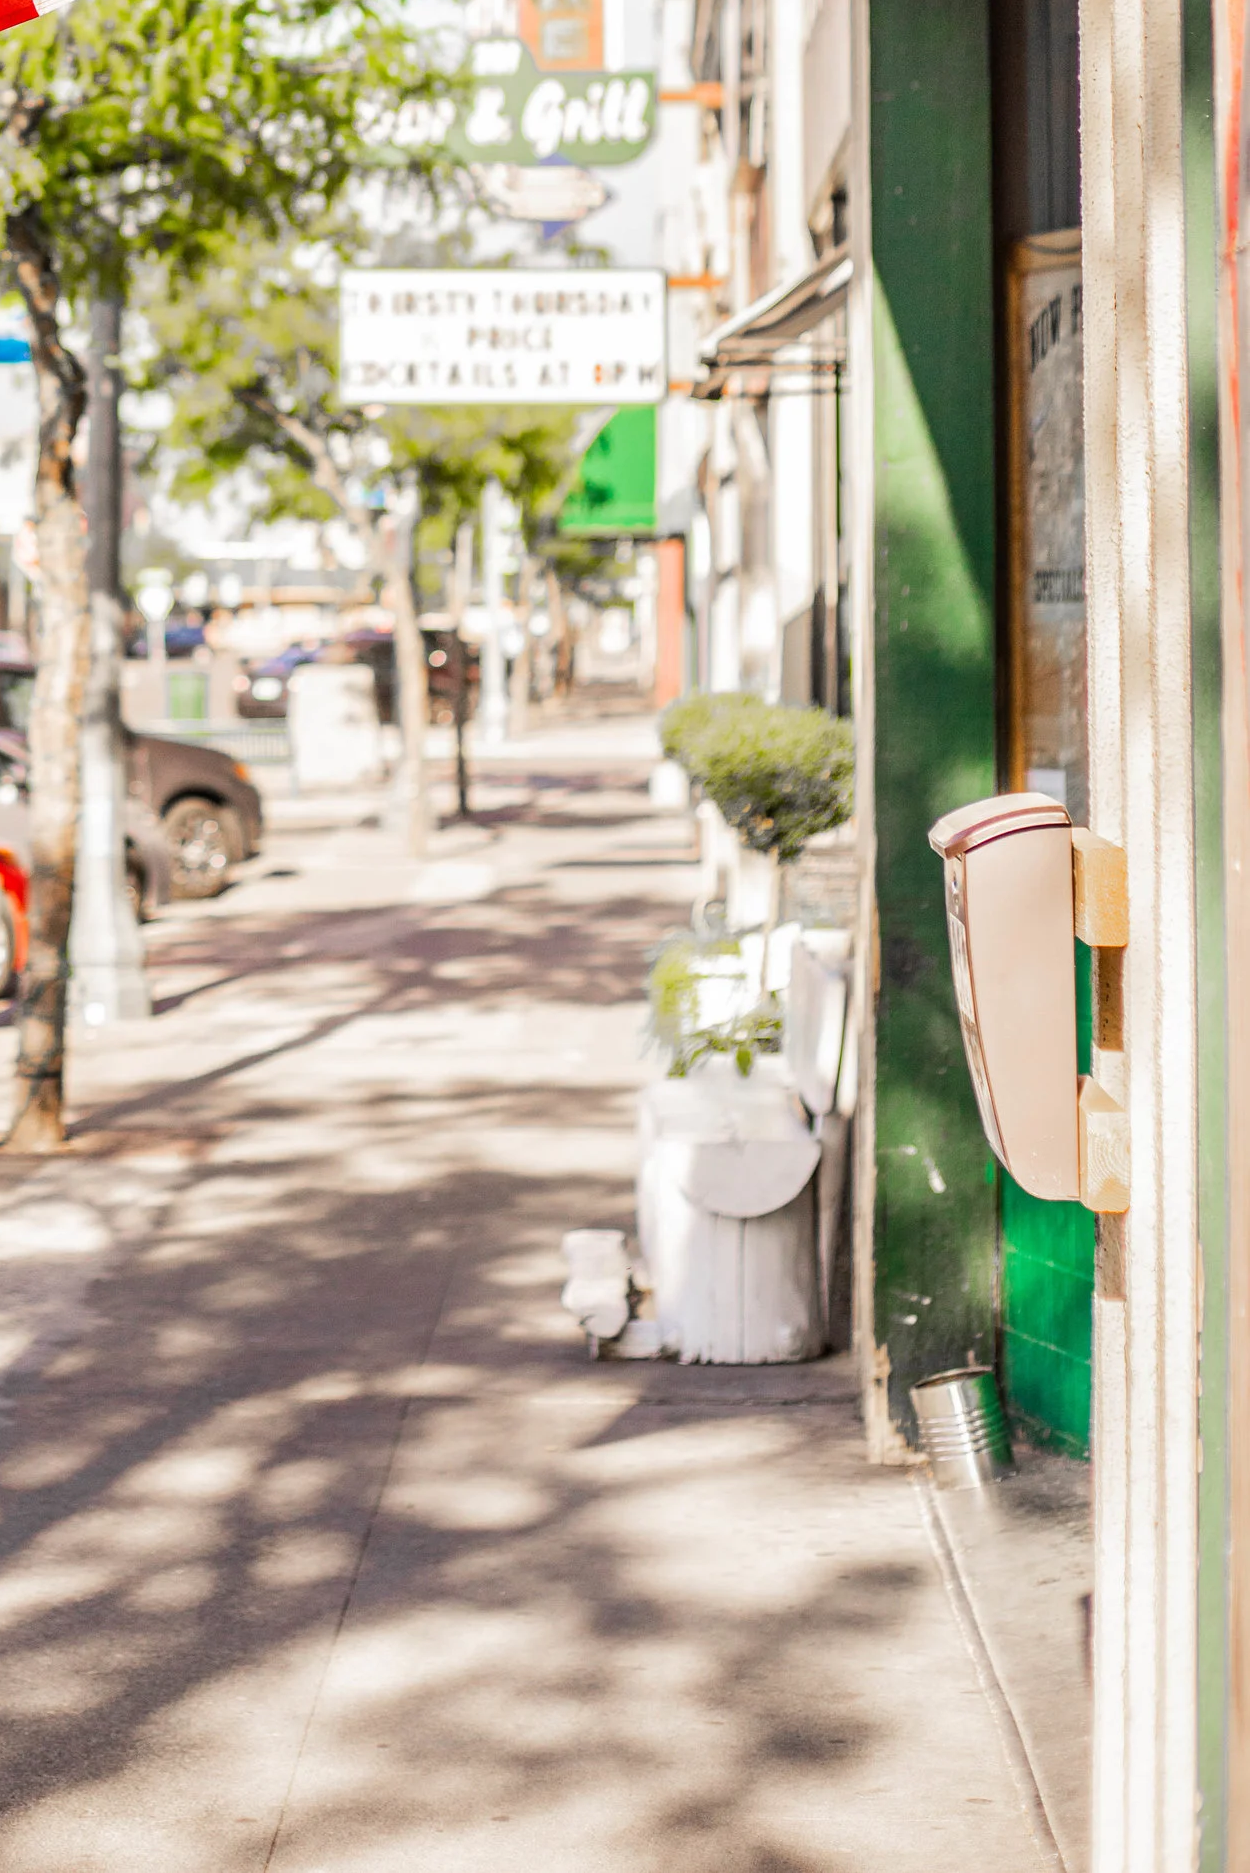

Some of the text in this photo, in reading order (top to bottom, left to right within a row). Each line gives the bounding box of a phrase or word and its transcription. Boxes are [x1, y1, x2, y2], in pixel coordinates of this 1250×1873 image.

[464, 86, 513, 146] &
[522, 78, 649, 158] Grill
[491, 288, 653, 317] THURSDAY
[465, 325, 553, 351] PRICE
[537, 359, 570, 387] AT
